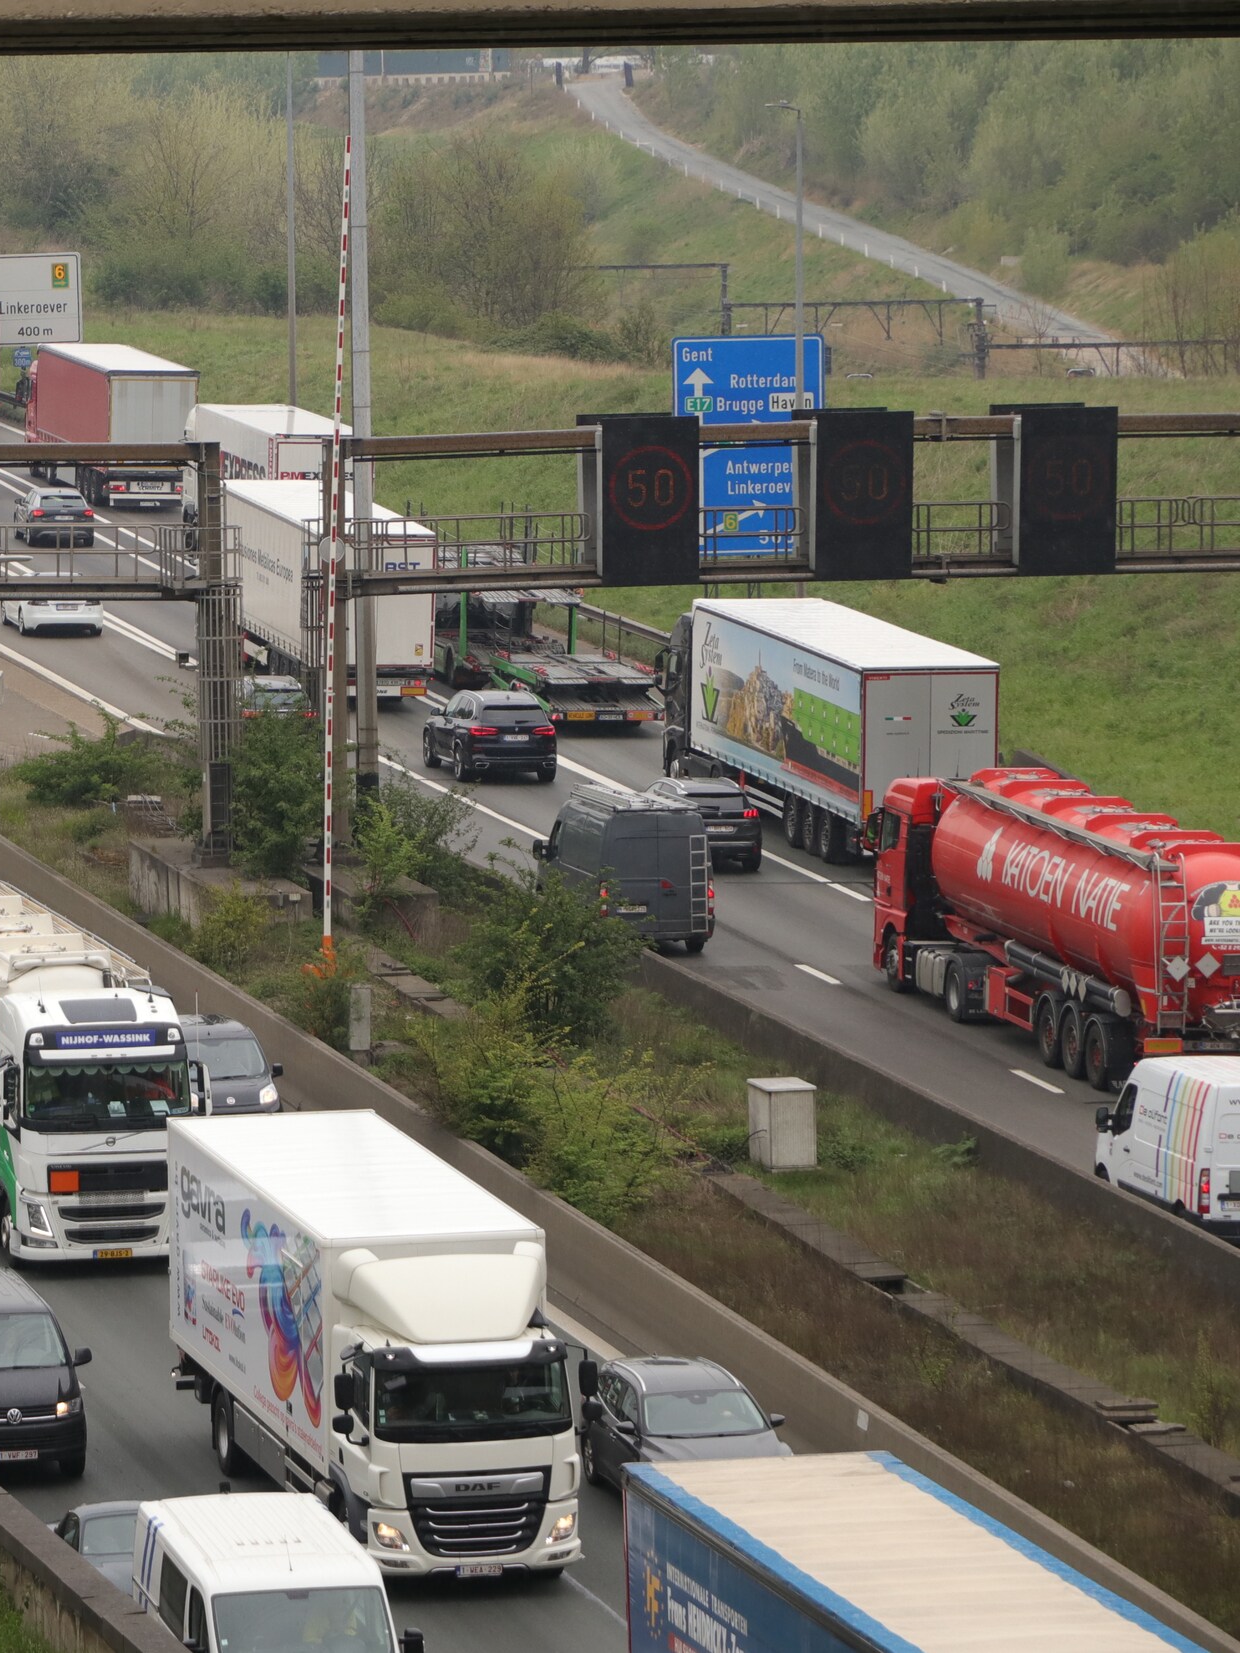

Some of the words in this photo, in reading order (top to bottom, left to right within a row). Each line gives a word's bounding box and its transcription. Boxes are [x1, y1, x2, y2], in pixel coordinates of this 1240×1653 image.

[54, 264, 65, 280] 6
[0, 302, 68, 315] Linkeroever
[17, 326, 40, 337] 400
[42, 327, 53, 336] m
[682, 347, 713, 362] Gent
[686, 398, 711, 411] E17
[716, 396, 764, 415] Brugge
[771, 395, 812, 410] Havn
[221, 449, 266, 480] EXPRESS
[726, 460, 793, 477] Antwerpe
[841, 465, 889, 501] 50
[1045, 457, 1093, 496] 50
[627, 468, 675, 507] 50
[728, 480, 792, 495] Linkeroev
[726, 514, 736, 529] 6
[948, 699, 981, 710] System
[1001, 839, 1075, 908] KATOEN
[1071, 868, 1131, 932] NATIE
[61, 1033, 150, 1045] NIJHOF-WASSINK
[181, 1165, 226, 1236] gavra
[201, 1259, 231, 1301] STARLIKE
[231, 1284, 245, 1312] EVO
[455, 1482, 501, 1492] DAF
[666, 1561, 709, 1609] INTERNATIONALE
